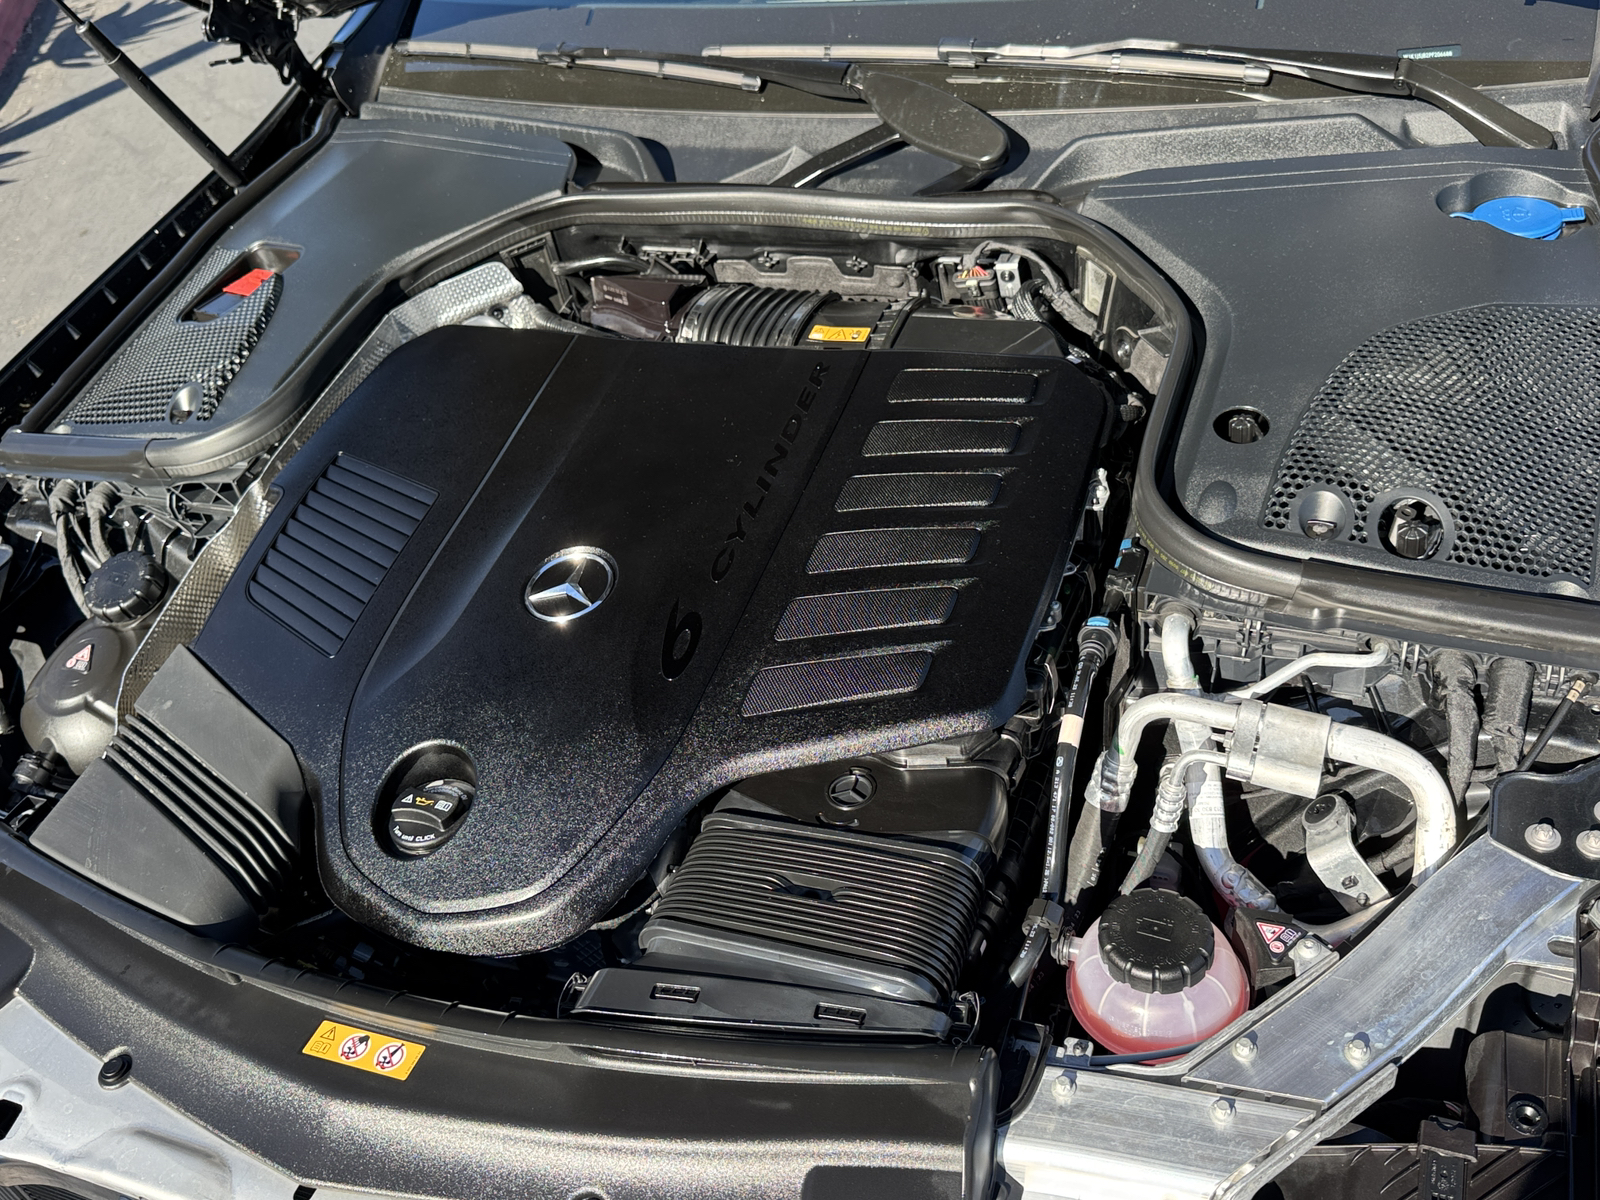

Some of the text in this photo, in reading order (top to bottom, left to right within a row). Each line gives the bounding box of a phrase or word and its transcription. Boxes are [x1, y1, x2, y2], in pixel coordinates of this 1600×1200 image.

[661, 362, 831, 681] 6 CYLINDER
[415, 833, 436, 842] CLICK
